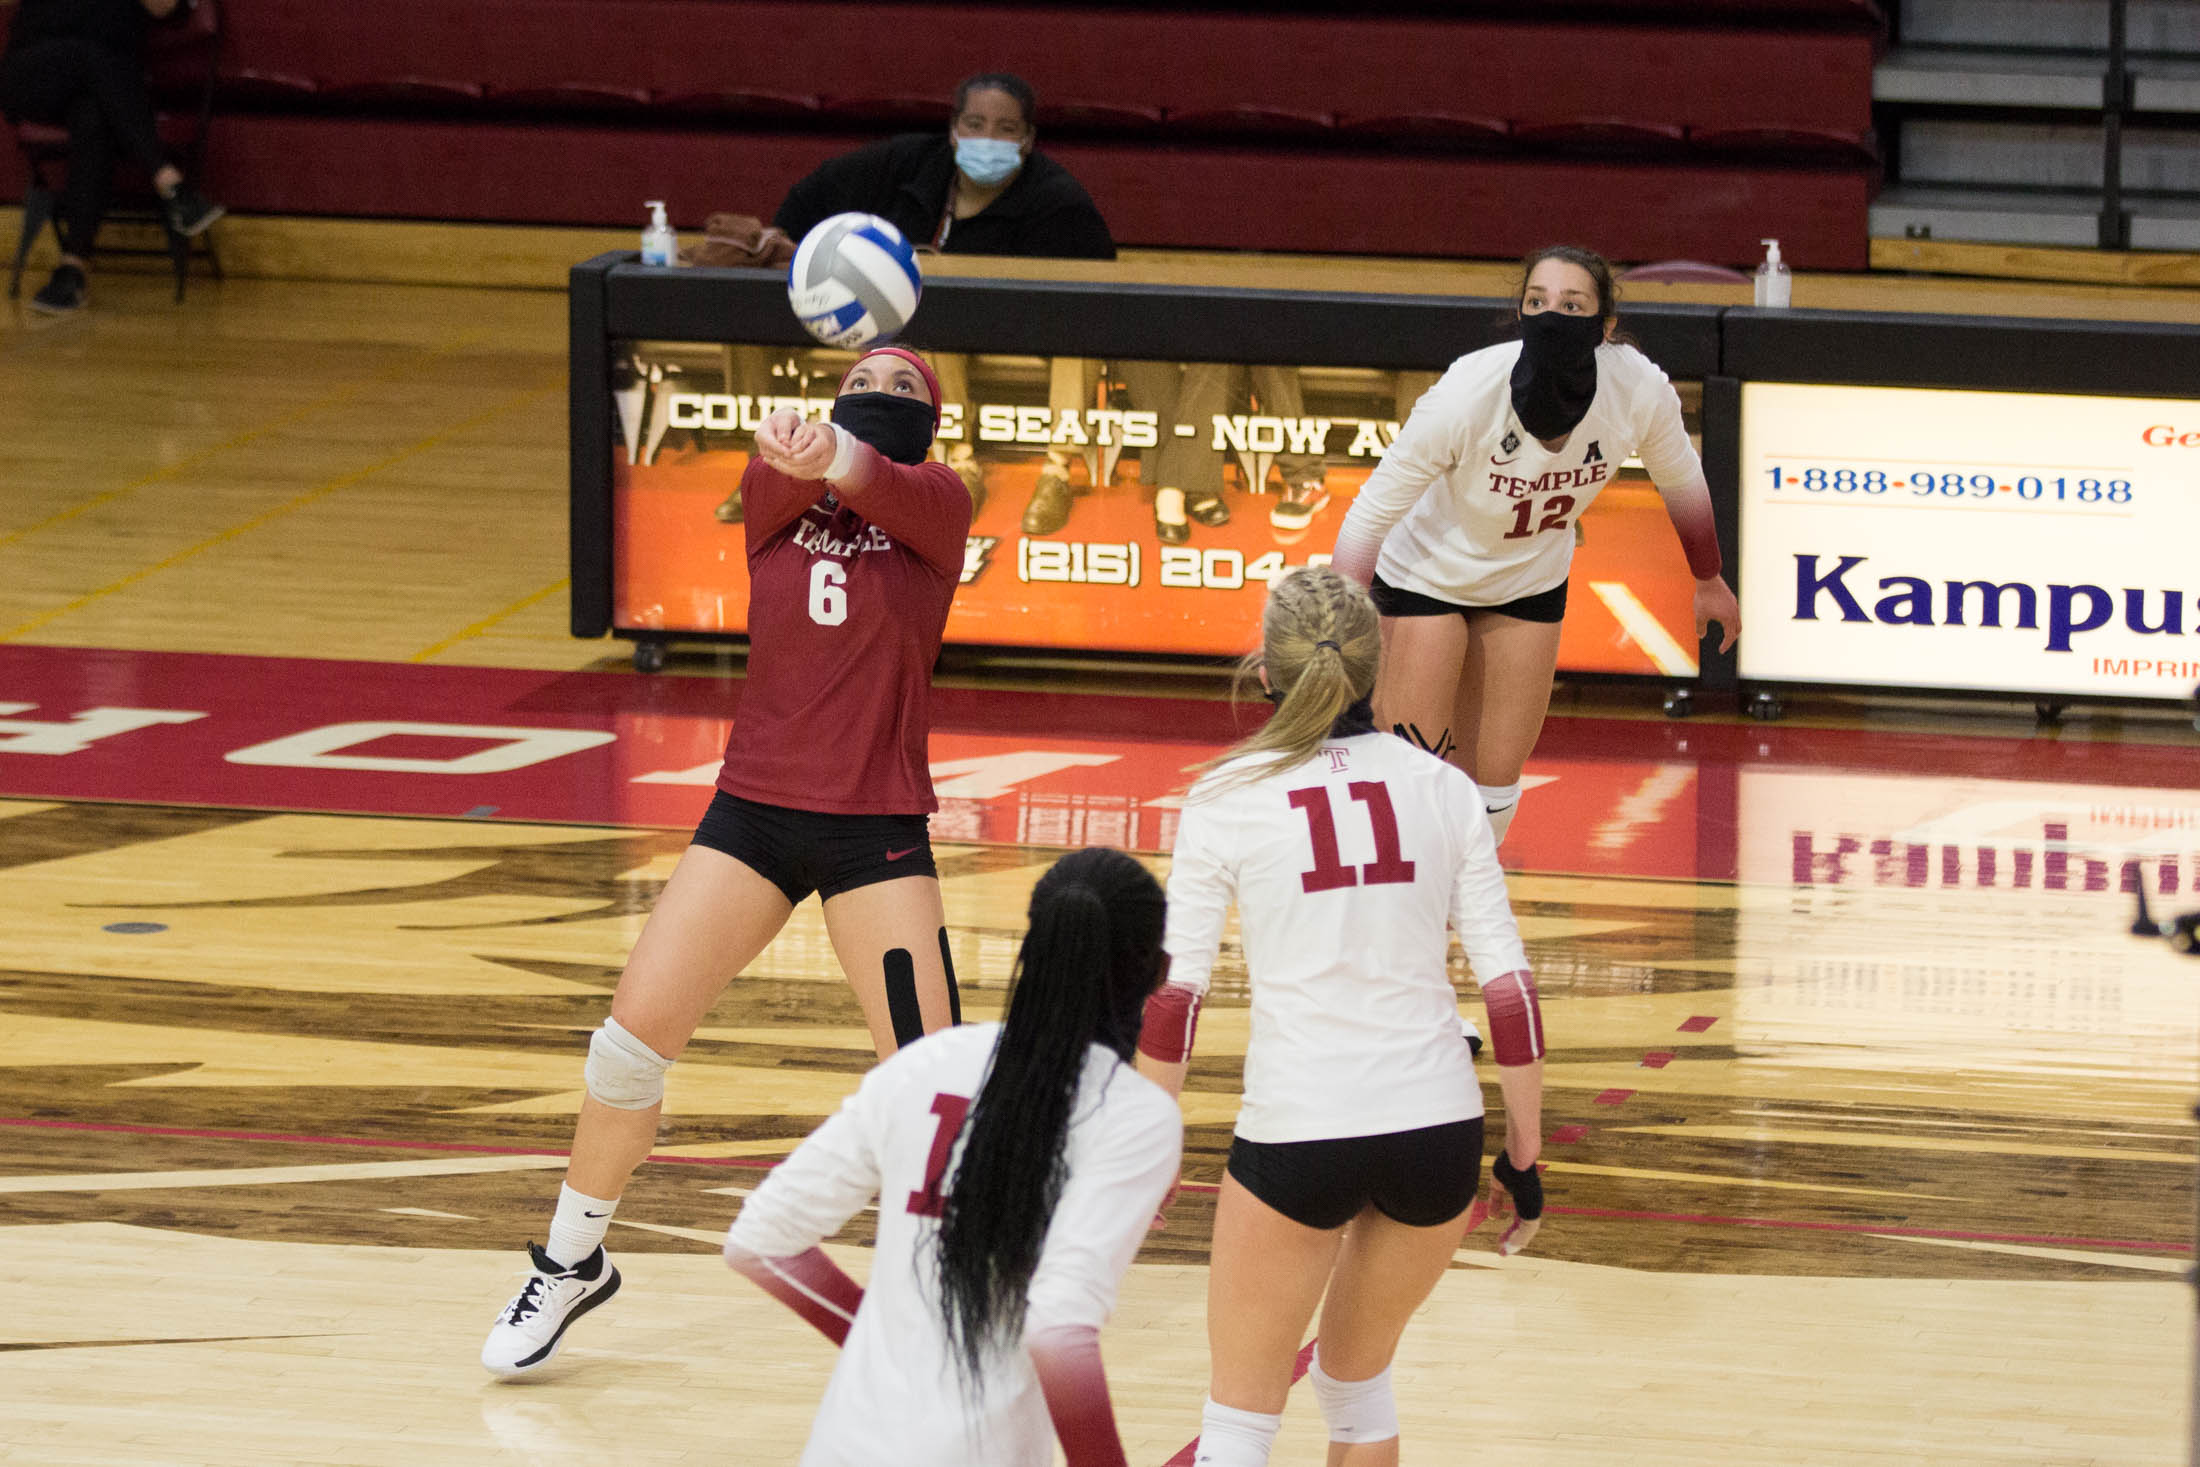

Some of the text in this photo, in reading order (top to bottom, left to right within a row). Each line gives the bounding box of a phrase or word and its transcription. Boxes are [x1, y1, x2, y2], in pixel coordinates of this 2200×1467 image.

[669, 394, 964, 440] COURTE
[979, 405, 1158, 448] SEATS
[1212, 414, 1331, 455] NOW
[1489, 463, 1608, 499] TEMPLE
[1765, 466, 2132, 503] 1-888-989-0188
[1504, 495, 1576, 539] 12
[1018, 536, 1140, 588] (215)
[809, 560, 847, 626] 6
[1792, 553, 2200, 653] Kampu
[1287, 781, 1415, 893] 11
